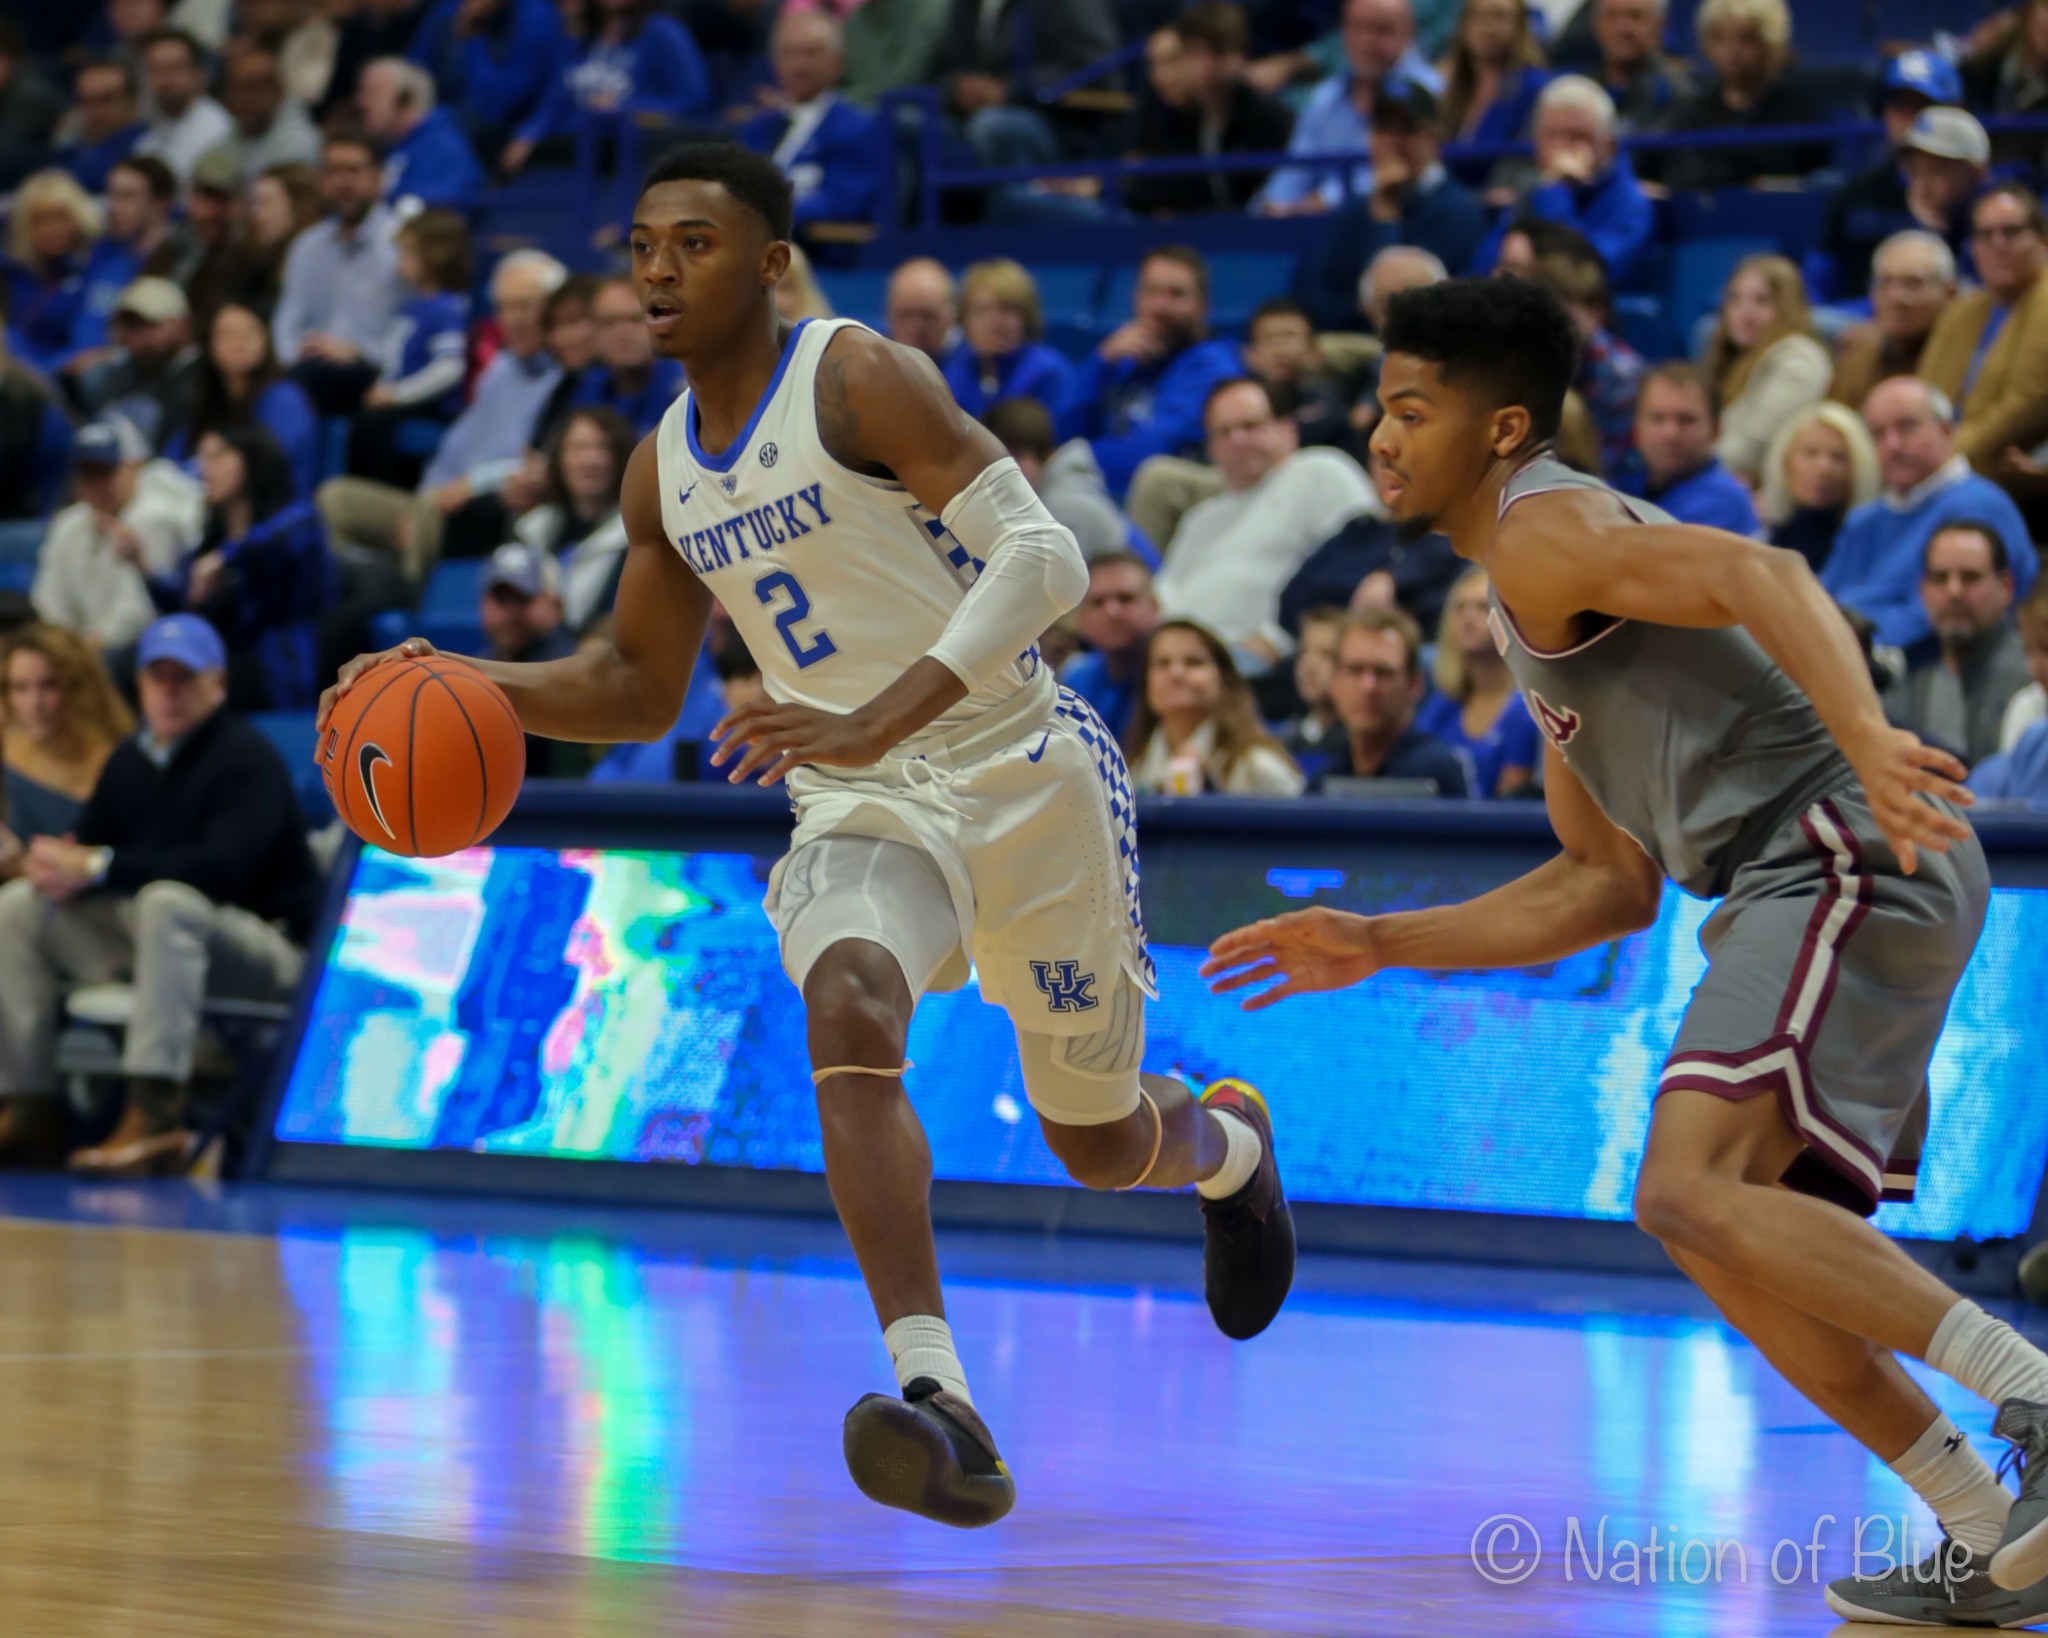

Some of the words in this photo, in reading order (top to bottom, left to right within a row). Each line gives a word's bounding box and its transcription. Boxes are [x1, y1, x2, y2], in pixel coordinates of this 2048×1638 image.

[760, 443, 778, 467] SEC
[678, 481, 832, 575] KENTUCKY
[753, 568, 841, 670] 2
[1029, 960, 1098, 1012] UK
